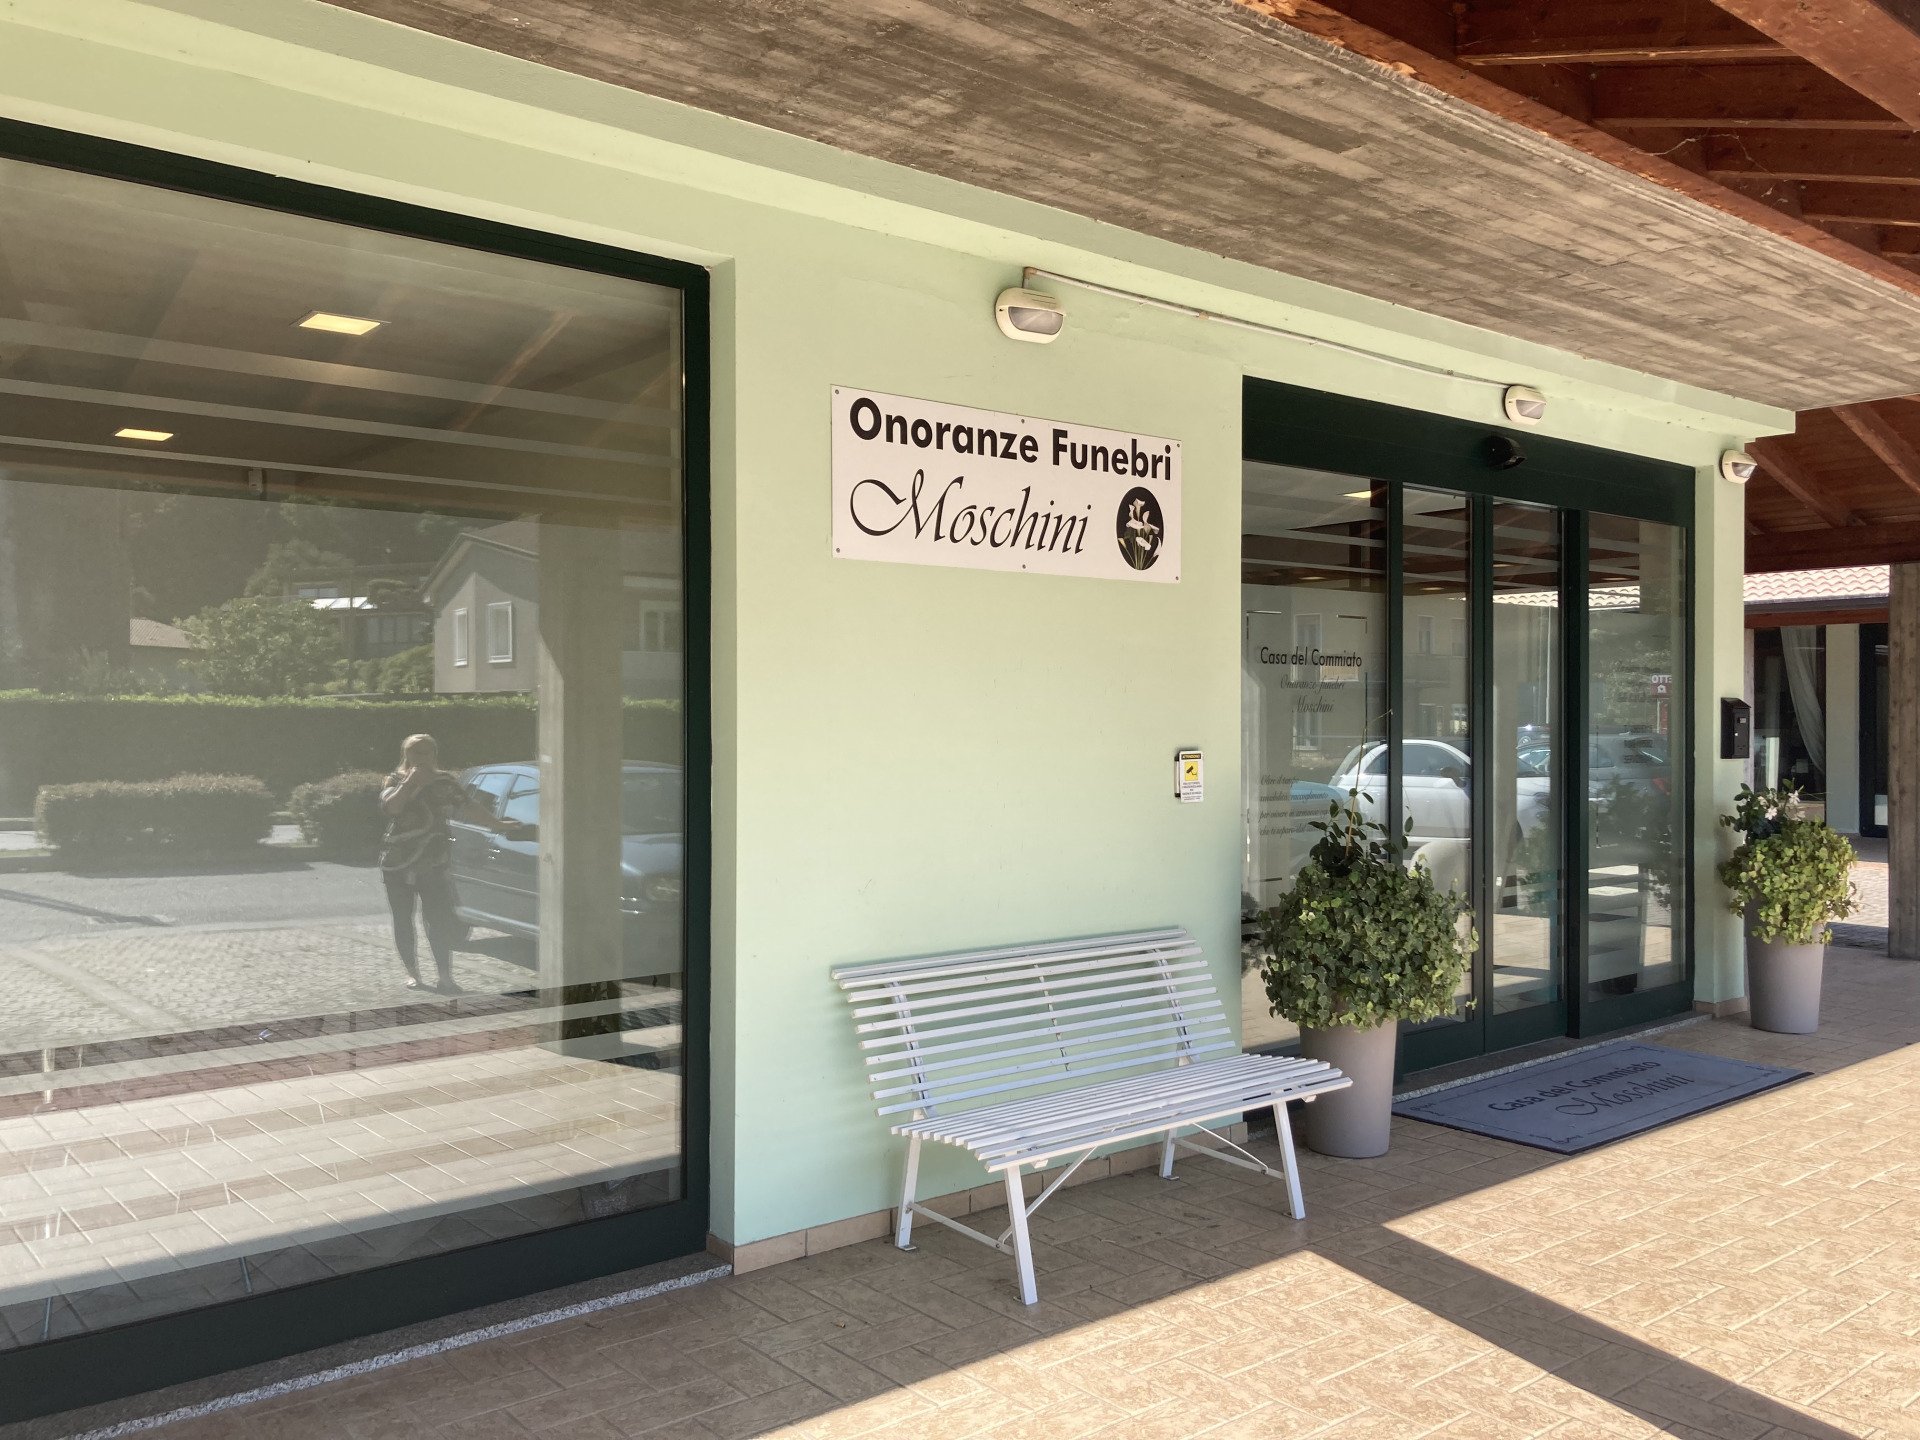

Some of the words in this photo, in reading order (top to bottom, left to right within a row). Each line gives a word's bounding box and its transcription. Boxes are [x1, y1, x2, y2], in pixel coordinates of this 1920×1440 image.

[850, 397, 1039, 463] Onoranze
[1052, 428, 1171, 481] Funebri
[850, 469, 1091, 554] Moschini
[1260, 646, 1287, 665] Casa
[1291, 646, 1308, 666] del
[1311, 648, 1362, 668] Commiato
[1292, 694, 1335, 713] Moschini
[1488, 1095, 1544, 1111] Casa
[1536, 1085, 1577, 1099] del
[1567, 1060, 1662, 1088] Commiato
[1555, 1072, 1696, 1116] Moschini
